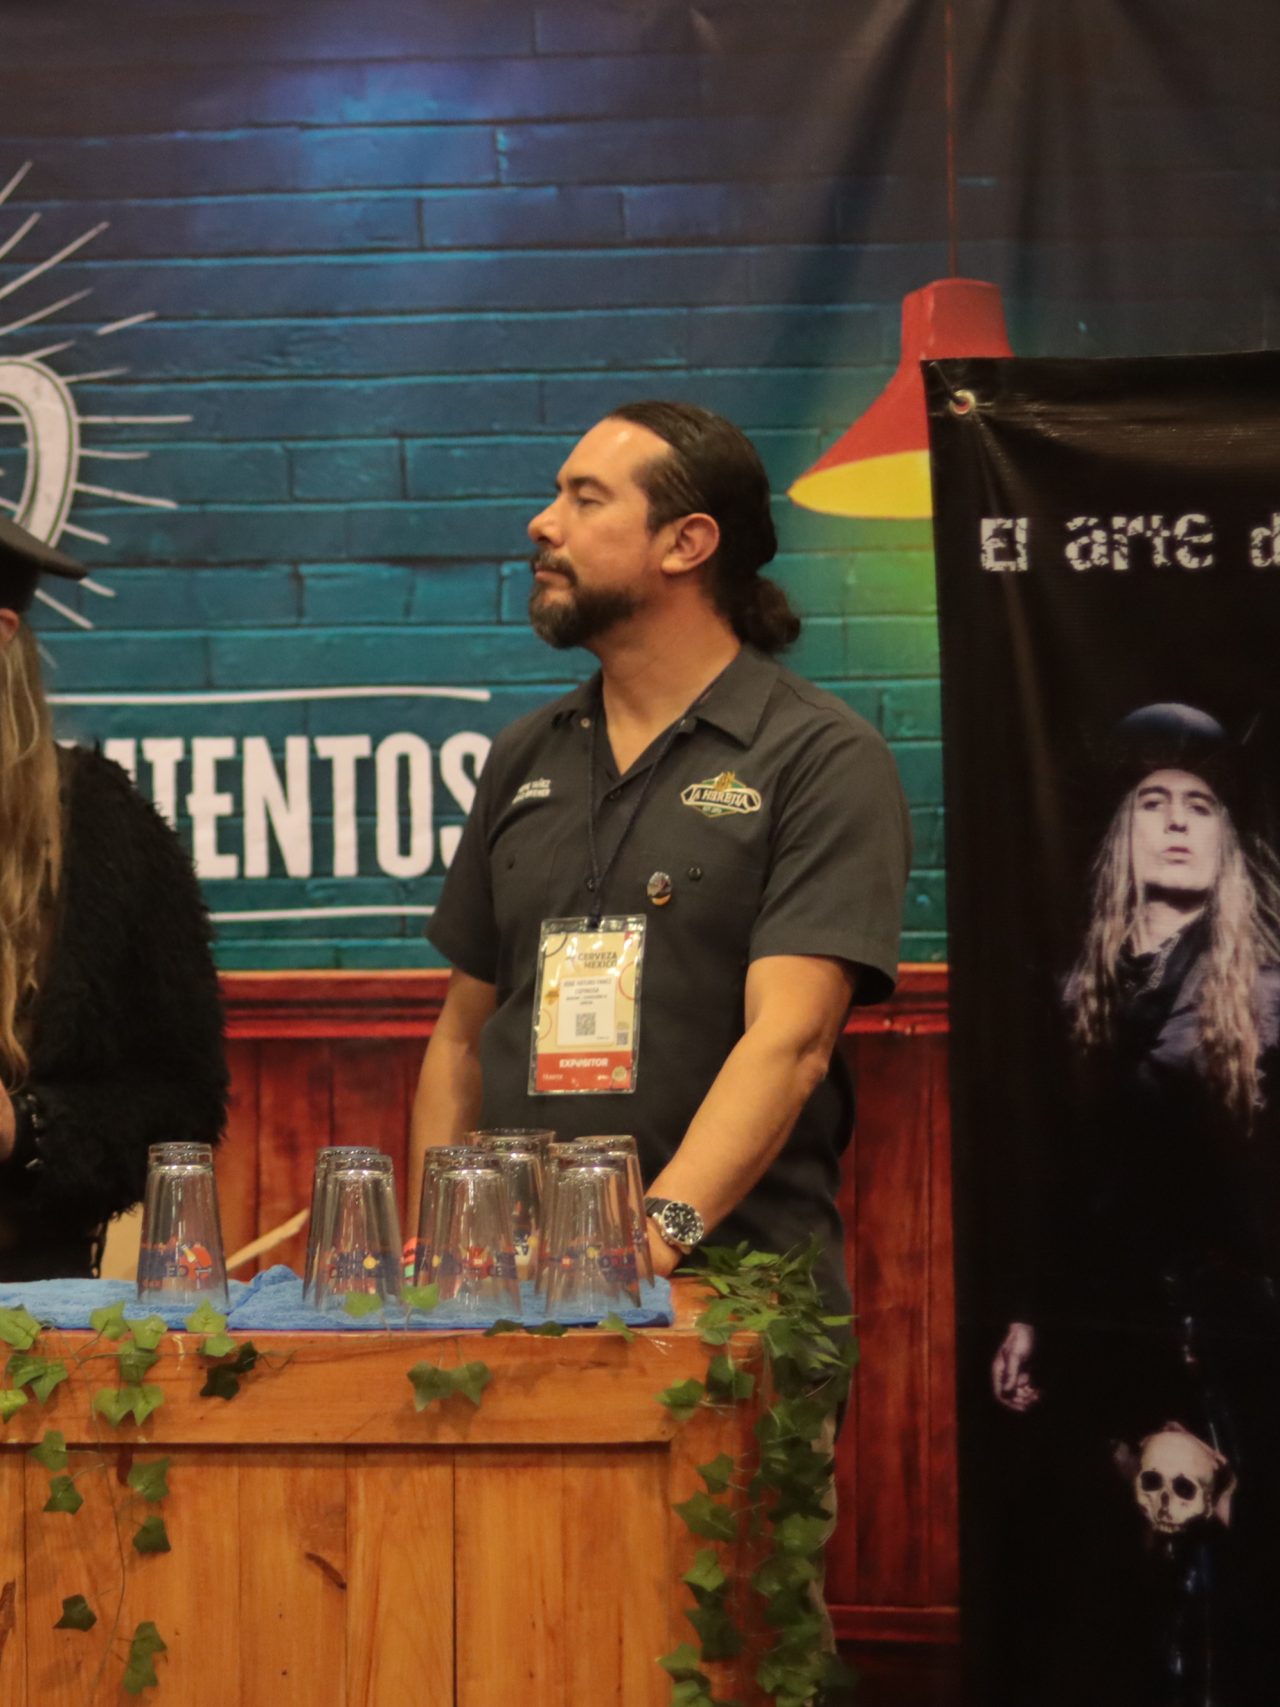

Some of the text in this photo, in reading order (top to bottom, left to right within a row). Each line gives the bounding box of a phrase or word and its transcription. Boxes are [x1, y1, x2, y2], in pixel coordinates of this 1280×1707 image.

[980, 516, 1029, 572] El
[1065, 513, 1214, 571] arte
[578, 951, 618, 961] CERVEZA
